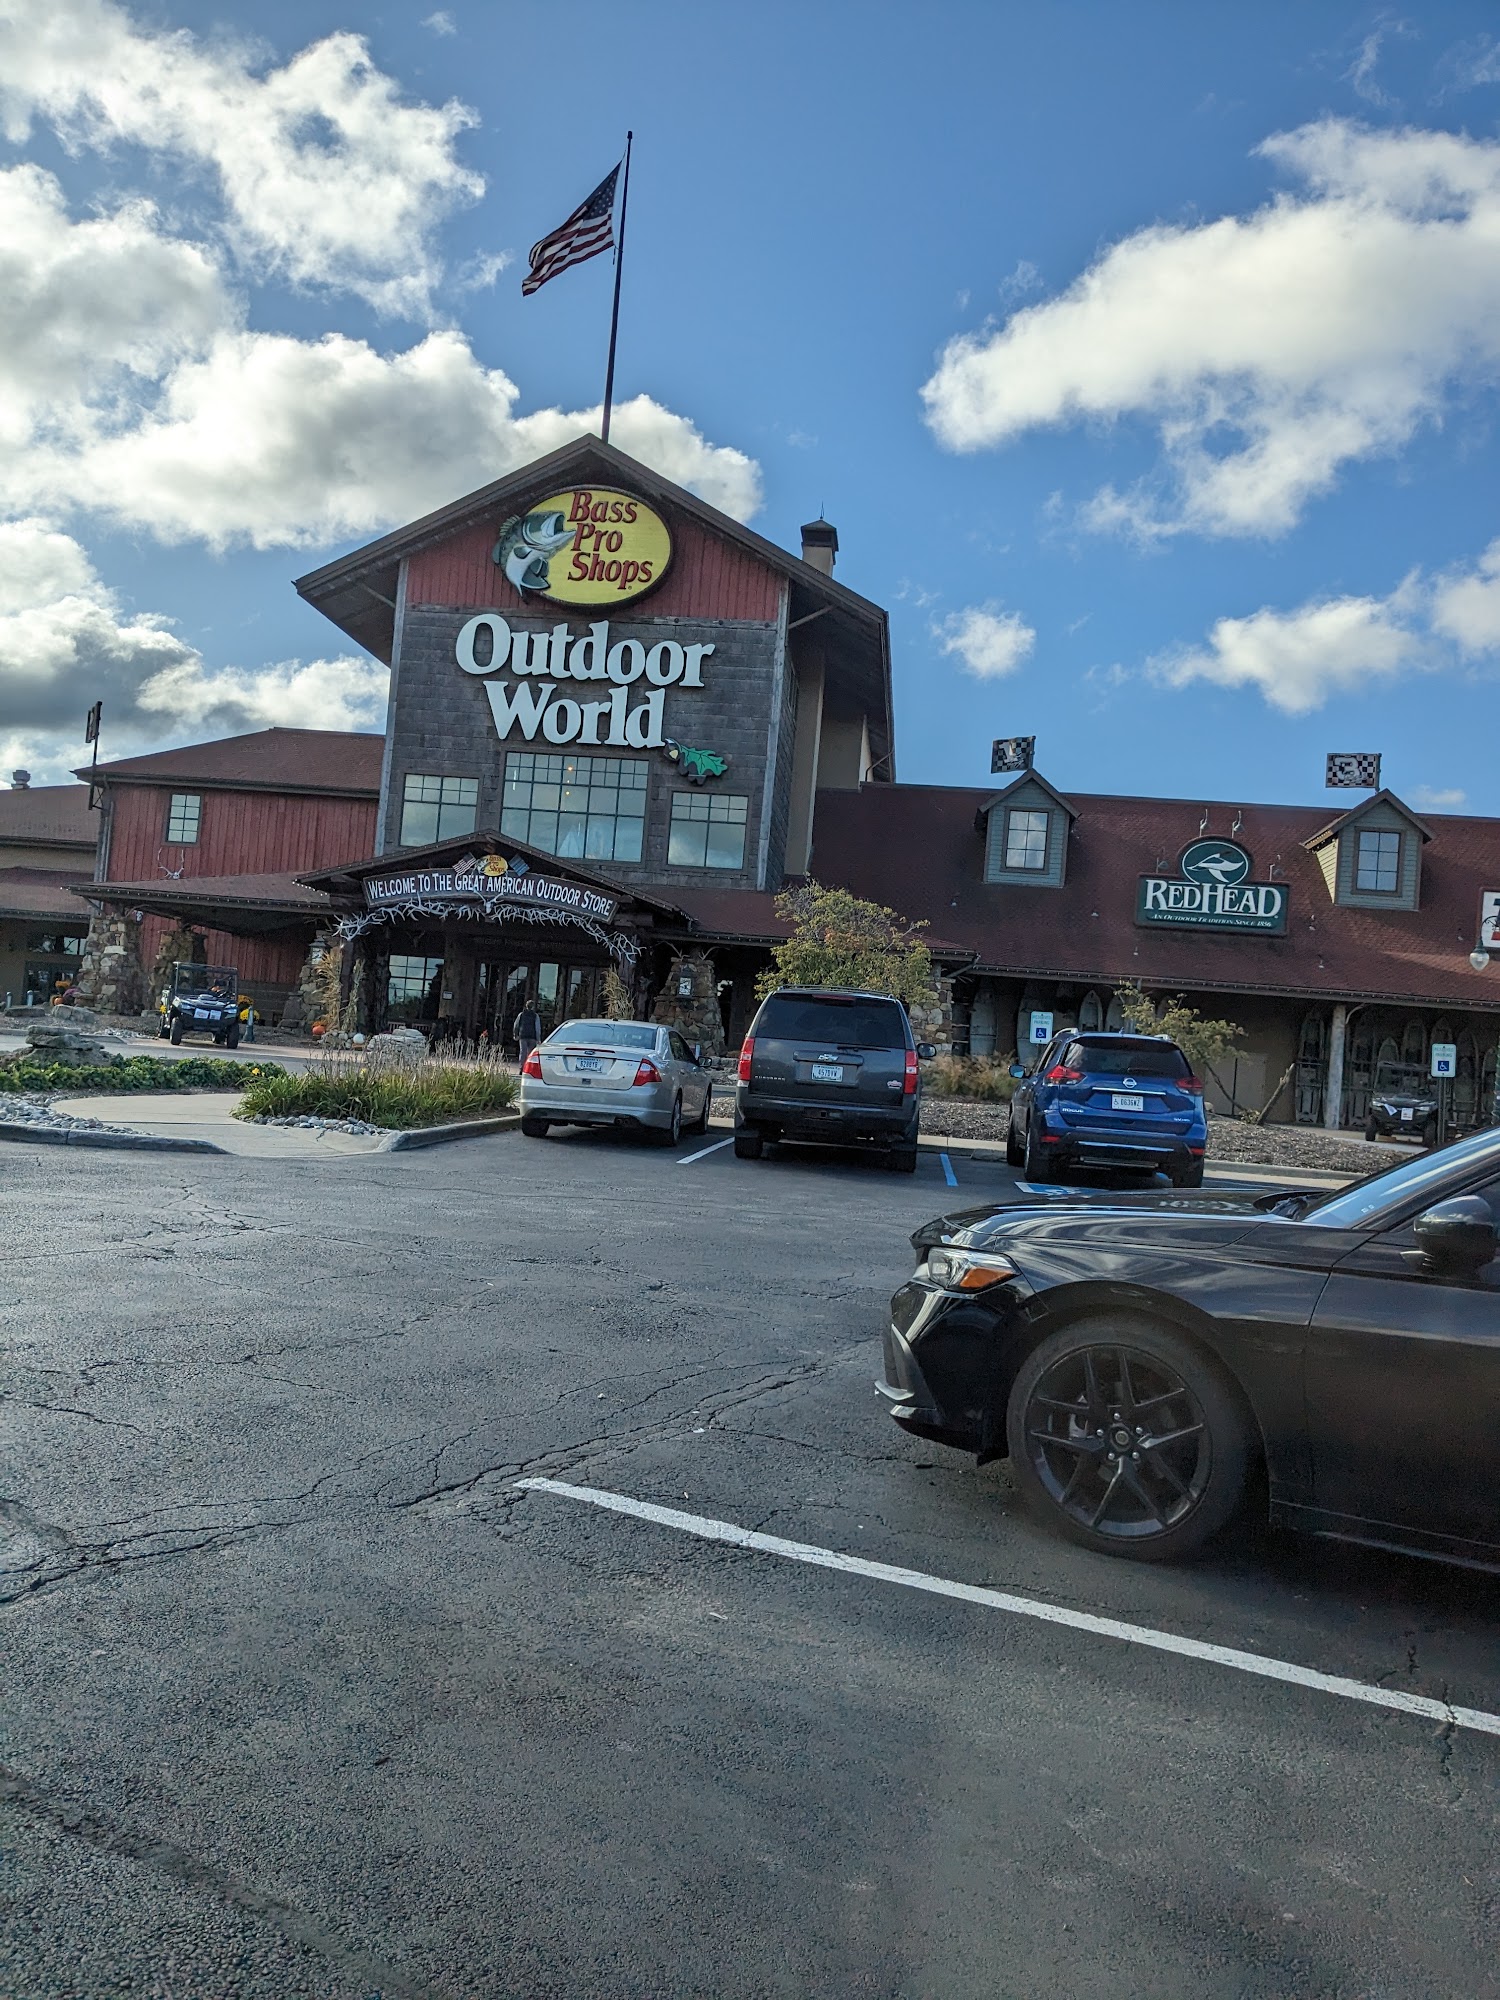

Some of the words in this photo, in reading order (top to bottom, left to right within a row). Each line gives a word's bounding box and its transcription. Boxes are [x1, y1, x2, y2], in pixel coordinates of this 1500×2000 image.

[567, 491, 639, 524] Bass
[570, 523, 623, 553] Pro
[567, 552, 653, 590] Shops
[455, 613, 715, 688] Outdoor
[483, 680, 665, 749] World
[368, 879, 417, 899] WELCOME
[418, 874, 431, 893] TO
[432, 872, 452, 891] THE
[454, 874, 485, 892] GREAT
[486, 876, 534, 896] AMERICAN
[536, 879, 581, 905] OUTDOOR
[581, 890, 613, 917] STORE
